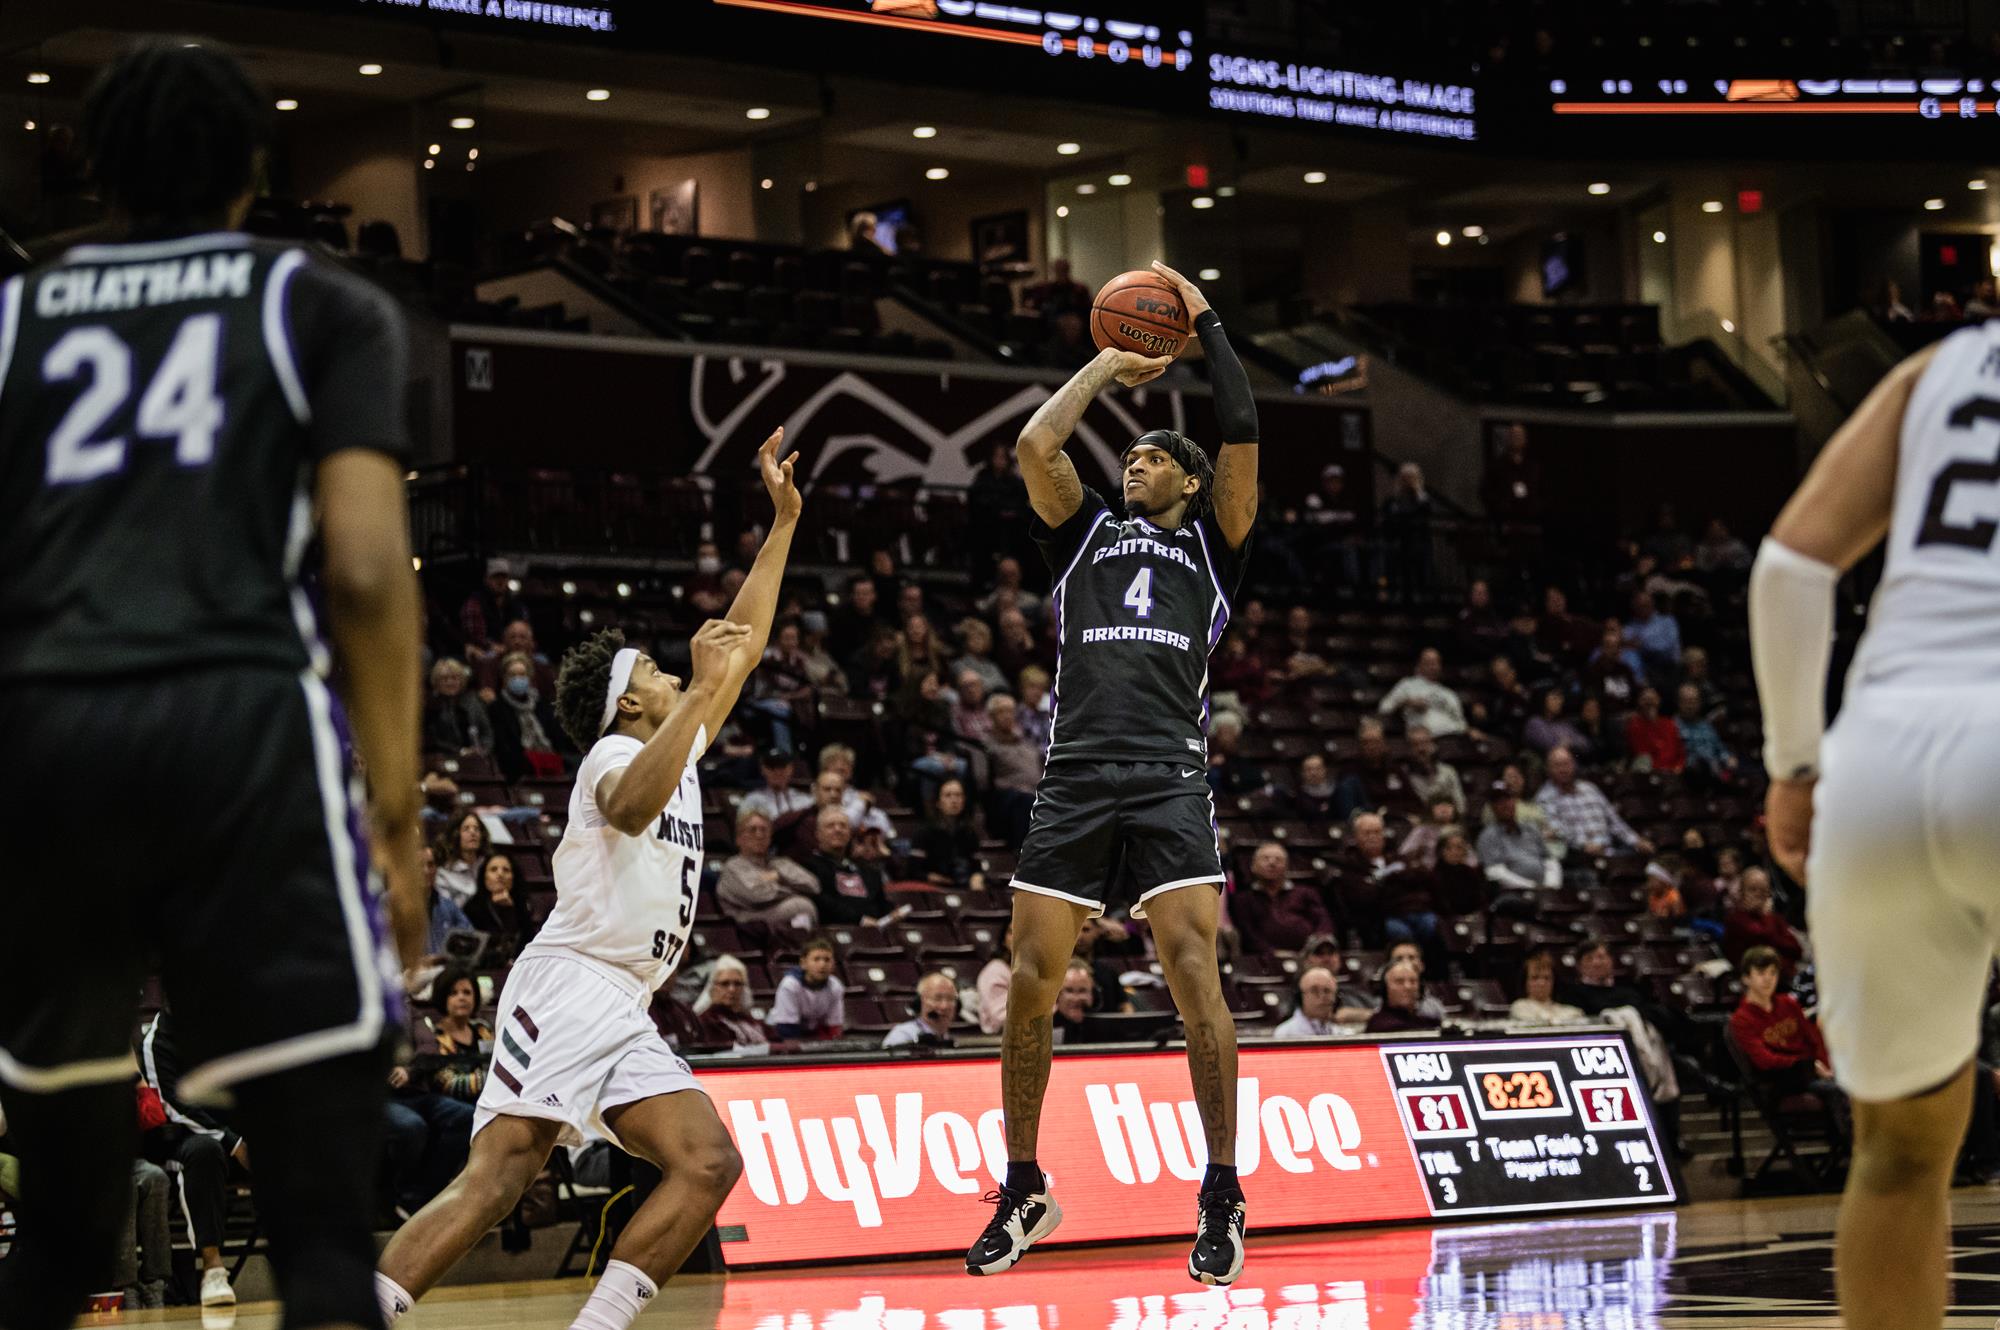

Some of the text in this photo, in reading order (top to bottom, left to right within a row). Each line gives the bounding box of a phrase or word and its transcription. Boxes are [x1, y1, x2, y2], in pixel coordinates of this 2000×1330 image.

[1042, 31, 1192, 71] GROUP
[36, 252, 252, 318] CHATHAM
[1119, 321, 1178, 353] Wilson
[42, 312, 225, 485] 24
[1092, 538, 1197, 571] CENTRAL
[1124, 567, 1154, 618] 4
[1082, 626, 1190, 651] ARKANSAS
[679, 856, 696, 928] 5
[1394, 1053, 1452, 1082] MSU
[1571, 1047, 1625, 1075] UCA
[1483, 1071, 1554, 1109] 8:23
[1591, 1088, 1624, 1122] 57
[1418, 1096, 1458, 1131] 81
[1485, 1136, 1537, 1160] Team
[1582, 1134, 1599, 1156] 3
[1439, 1177, 1458, 1203] 3
[1633, 1166, 1653, 1191] 2
